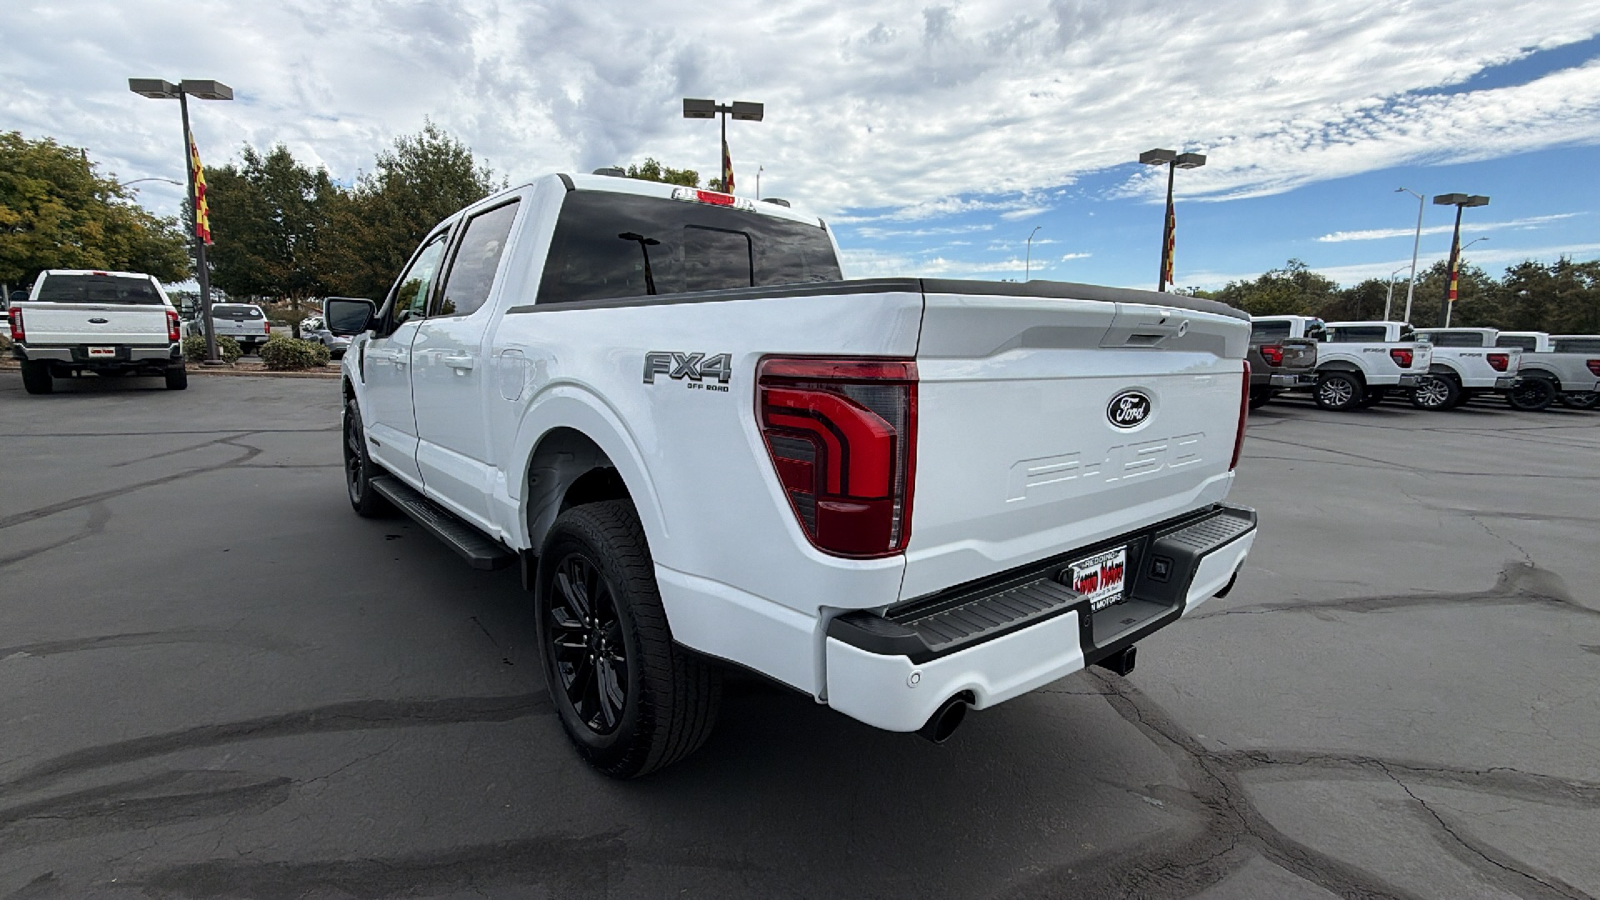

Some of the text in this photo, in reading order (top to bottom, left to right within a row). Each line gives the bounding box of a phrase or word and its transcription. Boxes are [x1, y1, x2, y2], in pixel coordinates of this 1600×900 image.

[643, 351, 733, 384] FX4
[706, 384, 729, 392] ROAD
[1116, 396, 1146, 422] Ford
[1006, 431, 1206, 503] F-150
[1096, 593, 1122, 610] MOTORS
